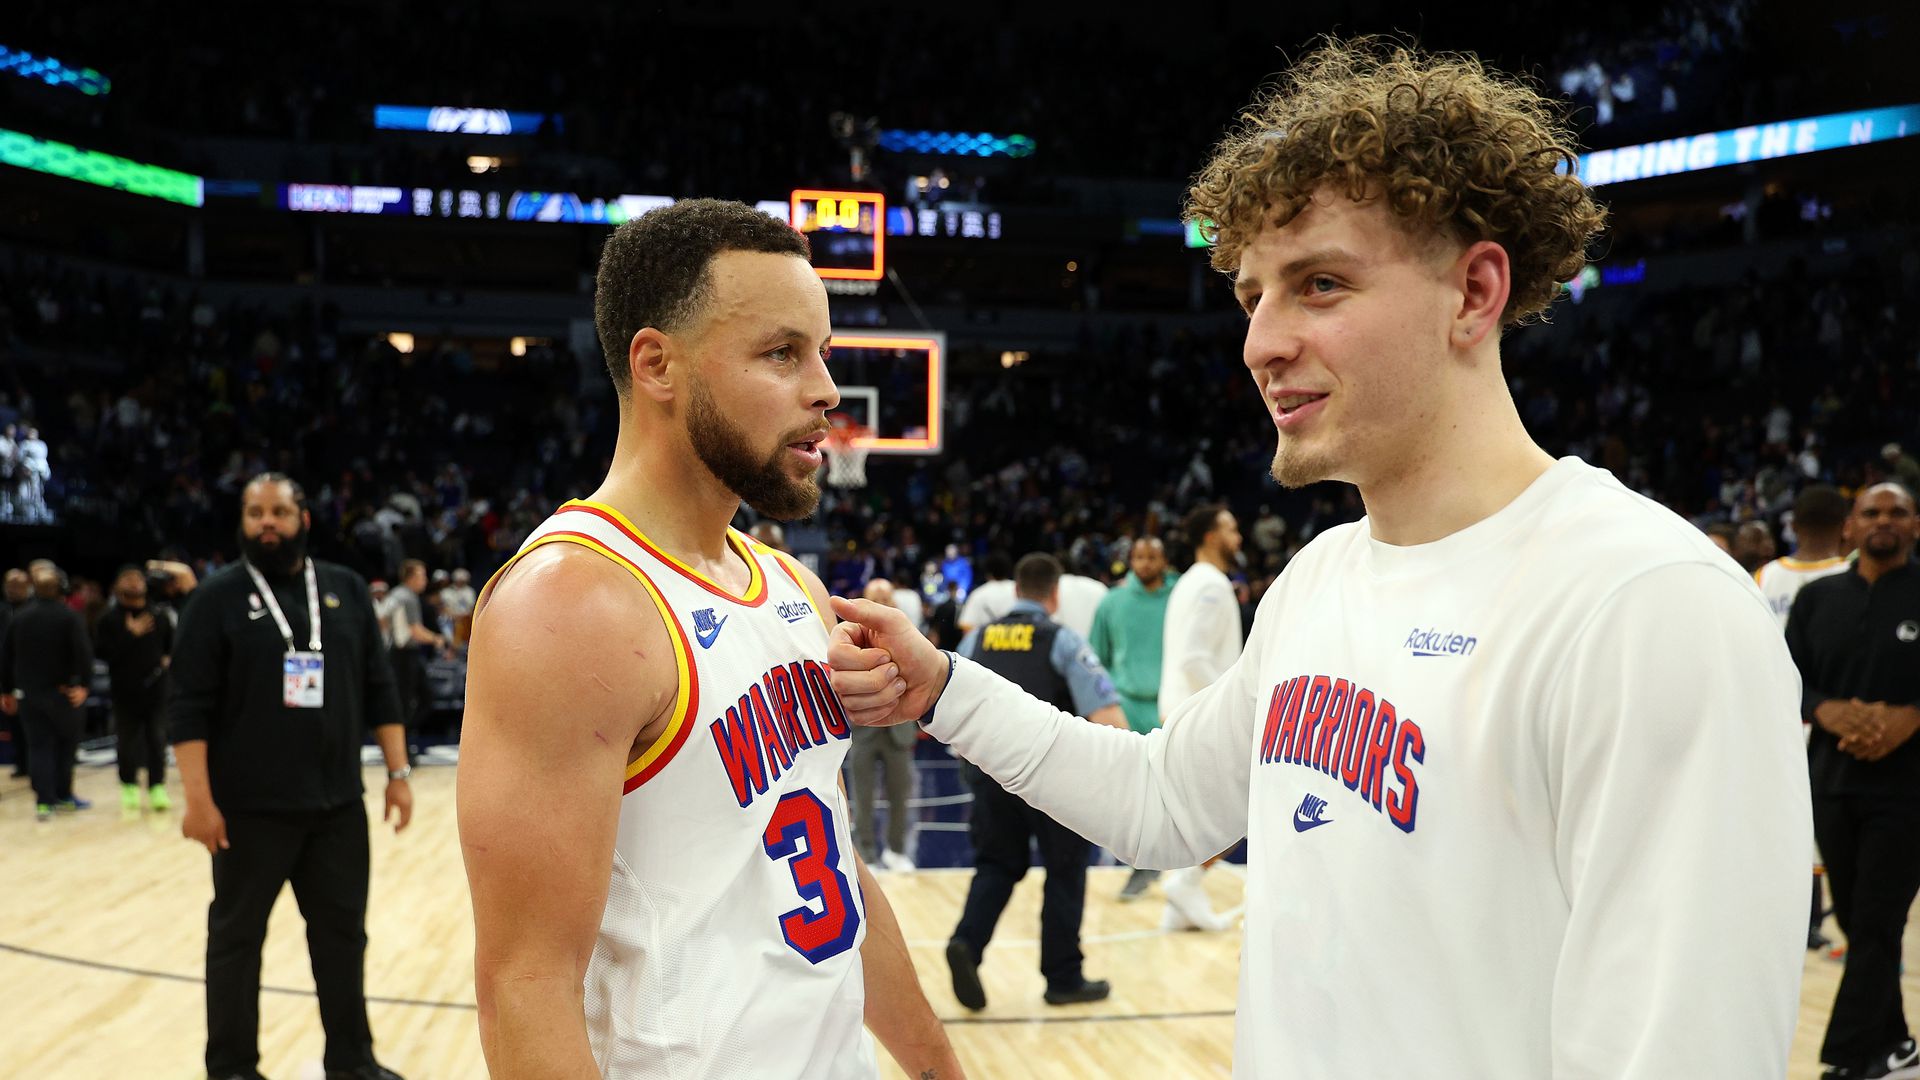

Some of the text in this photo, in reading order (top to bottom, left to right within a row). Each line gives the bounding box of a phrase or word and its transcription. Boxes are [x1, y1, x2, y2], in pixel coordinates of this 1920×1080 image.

[1585, 131, 1718, 187] BRING
[1733, 119, 1819, 164] THE
[982, 622, 1036, 652] POLICE
[1403, 627, 1477, 656] Rakuten
[709, 659, 852, 809] WARRIO
[1260, 675, 1426, 834] WARRIORS
[762, 787, 866, 965] 3
